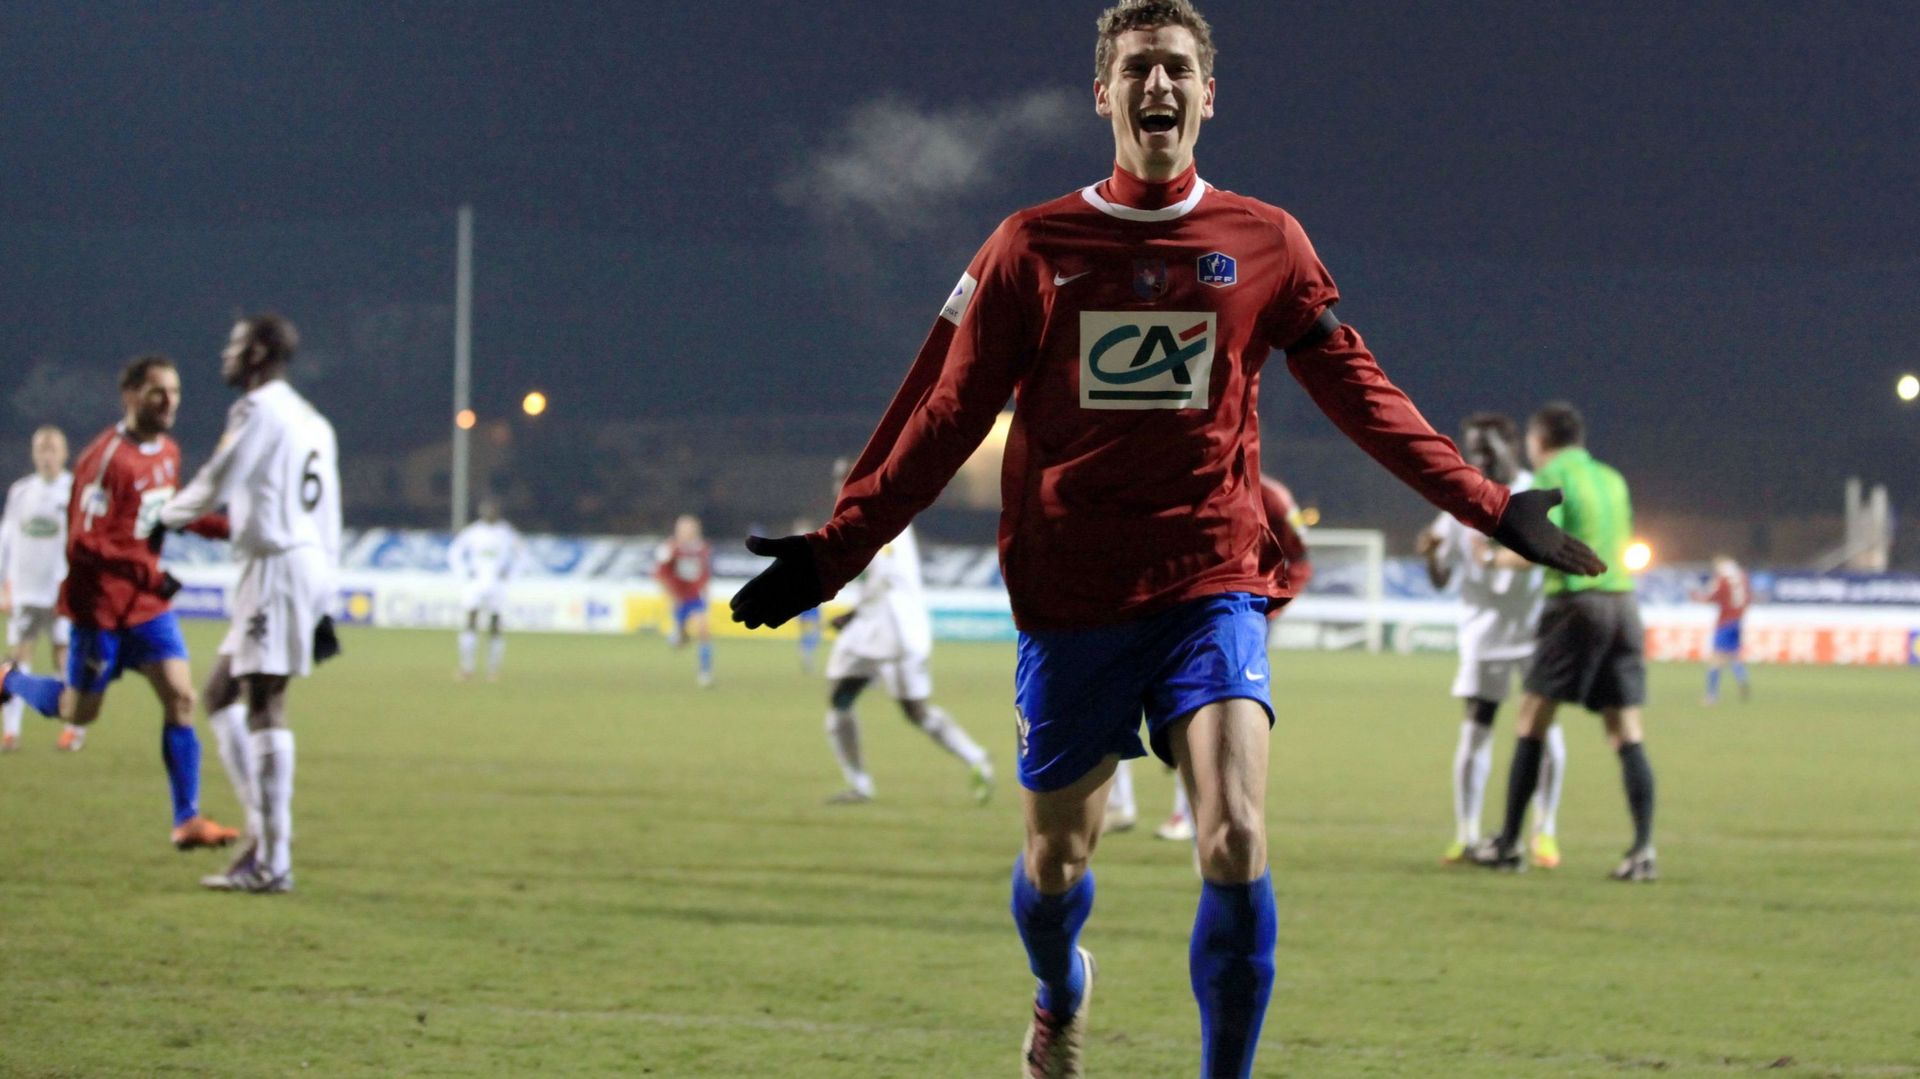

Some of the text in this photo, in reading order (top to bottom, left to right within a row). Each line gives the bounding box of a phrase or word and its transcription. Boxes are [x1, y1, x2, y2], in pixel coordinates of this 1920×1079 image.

[1088, 324, 1207, 385] CA
[299, 450, 323, 513] 6
[1832, 630, 1905, 664] SFR
